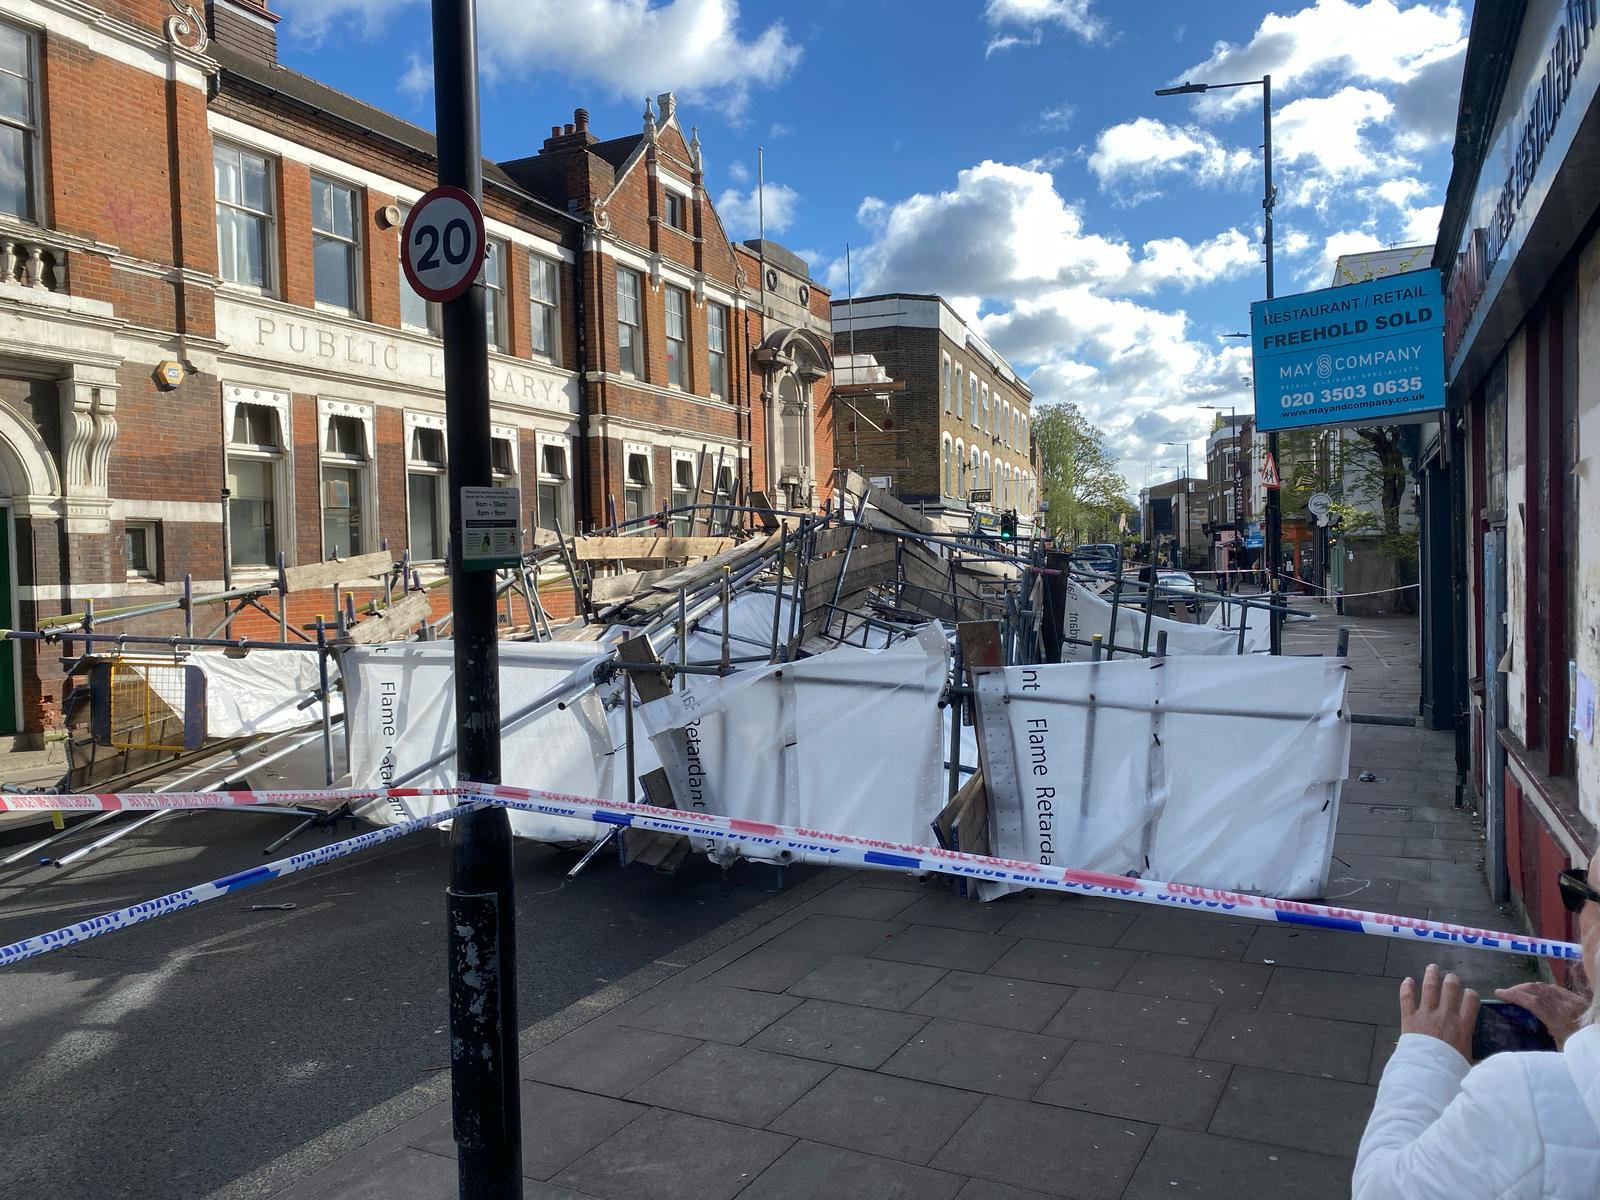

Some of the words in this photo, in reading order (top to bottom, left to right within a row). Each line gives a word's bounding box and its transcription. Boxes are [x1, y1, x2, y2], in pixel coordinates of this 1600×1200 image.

[415, 218, 471, 272] 20
[1263, 319, 1368, 349] FREEHOLD
[1375, 307, 1432, 330] SOLD
[1264, 298, 1360, 326] RESTAURANT
[1373, 286, 1428, 305] RETAIL
[254, 316, 400, 371] PUBLIC
[427, 352, 555, 402] LRARY
[1280, 362, 1313, 379] MAY
[1335, 345, 1422, 371] COMPANY
[1281, 391, 1315, 408] 020
[1320, 384, 1367, 403] 3503
[1373, 376, 1423, 396] 0635
[1281, 393, 1425, 418] www.mayandcompany.co.uk
[381, 682, 397, 736] Flame
[686, 718, 706, 808] Retardant
[1027, 718, 1049, 776] Flame
